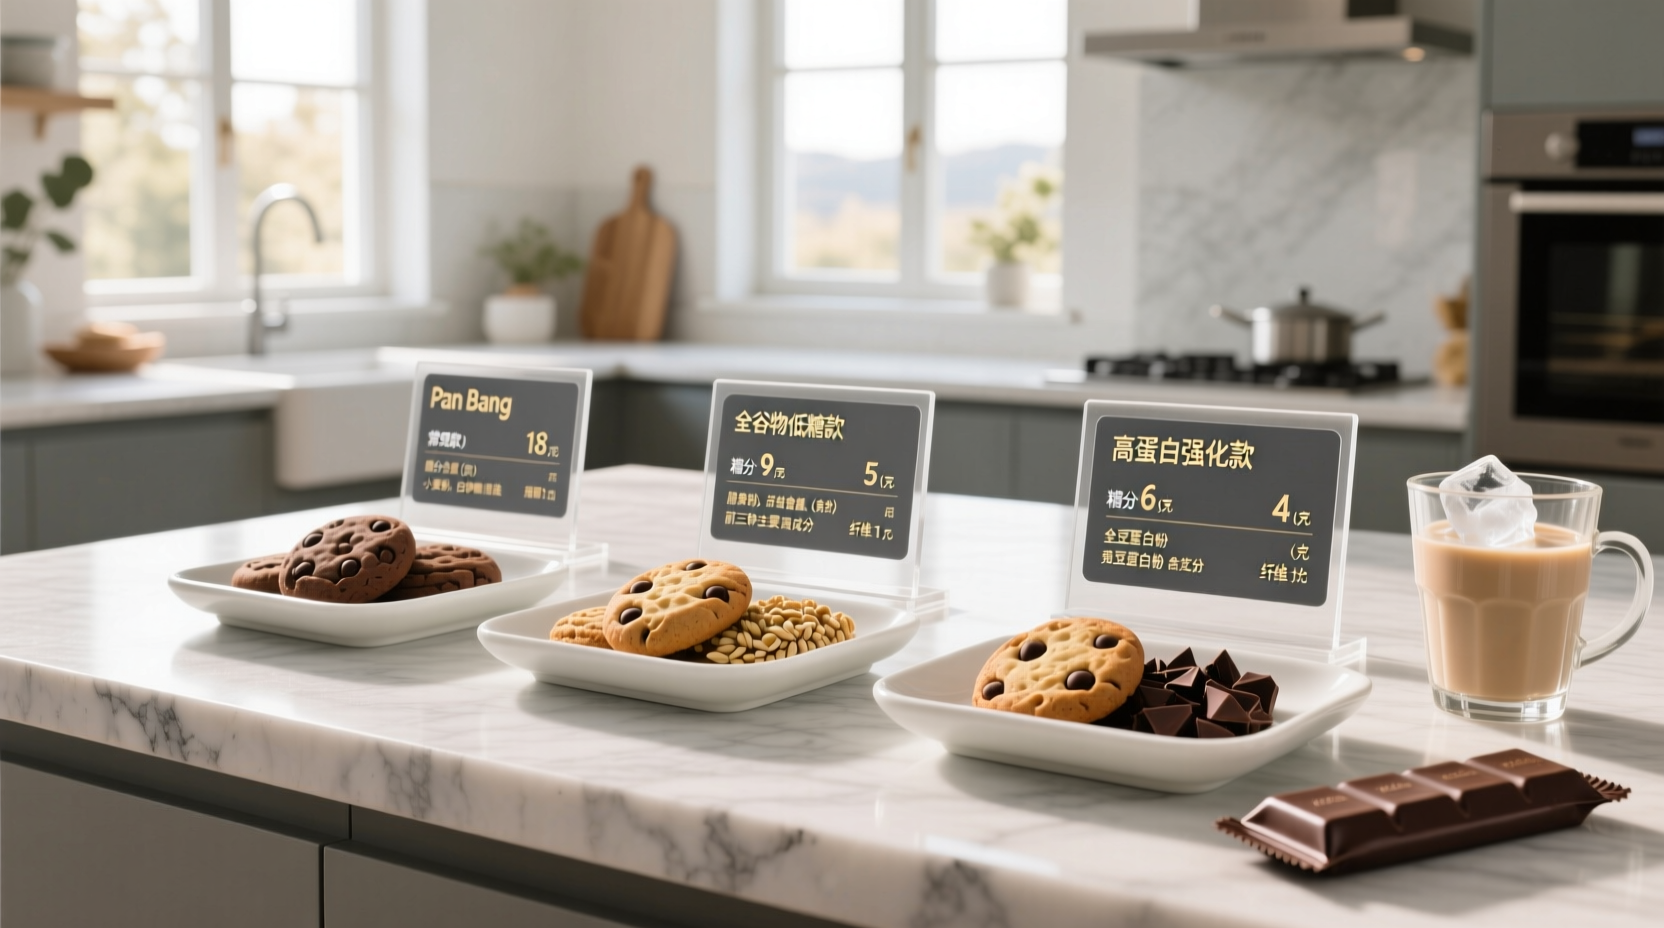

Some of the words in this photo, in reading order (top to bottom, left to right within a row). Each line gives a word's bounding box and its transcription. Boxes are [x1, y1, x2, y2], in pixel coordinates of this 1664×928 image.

[430, 386, 463, 411] Pan
[466, 388, 512, 421] Bang
[1112, 434, 1255, 470] 高蛋白强化款
